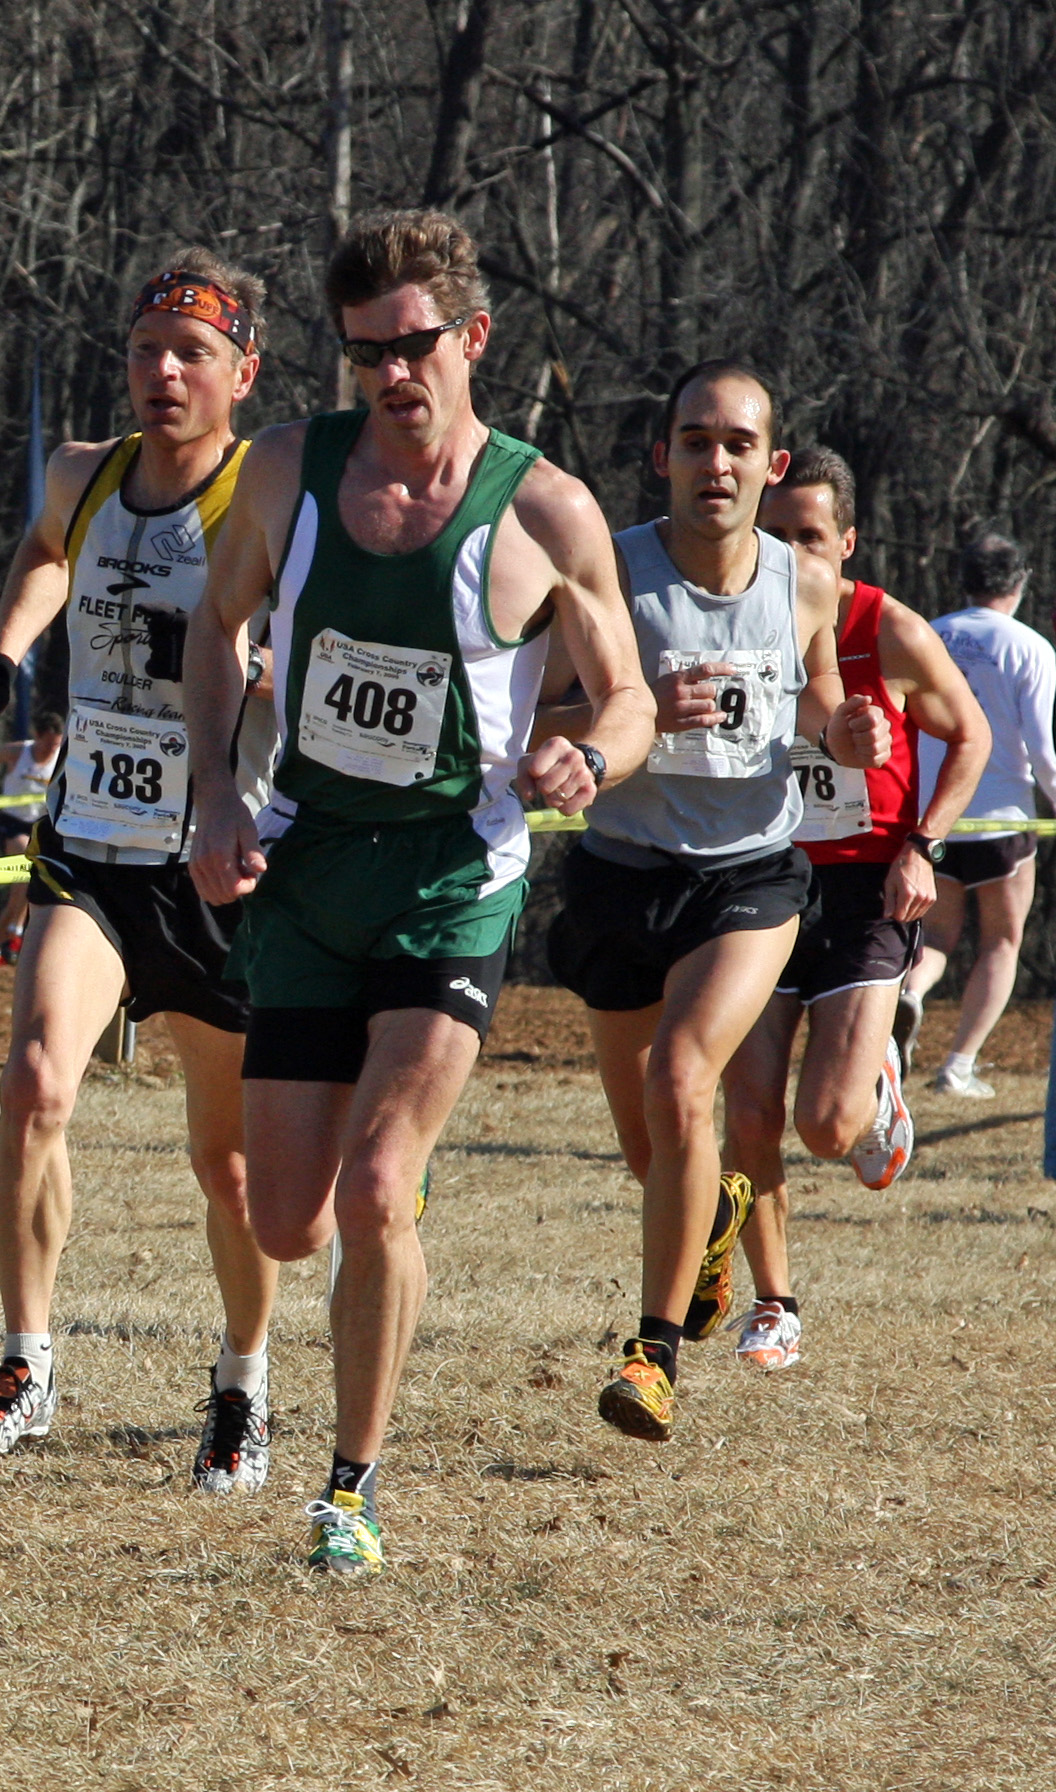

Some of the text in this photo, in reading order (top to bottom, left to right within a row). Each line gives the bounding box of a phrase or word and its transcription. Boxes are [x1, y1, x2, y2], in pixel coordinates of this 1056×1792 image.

[97, 556, 172, 577] BROOKS
[78, 595, 128, 621] FLEET
[337, 642, 418, 669] USA Cross Country
[342, 652, 408, 675] Championships
[101, 670, 153, 691] BOULDER
[110, 696, 157, 717] Racing
[324, 673, 417, 736] 408
[95, 729, 152, 745] Championships
[106, 723, 128, 733] Cross
[129, 727, 161, 739] Country
[89, 750, 163, 805] 183
